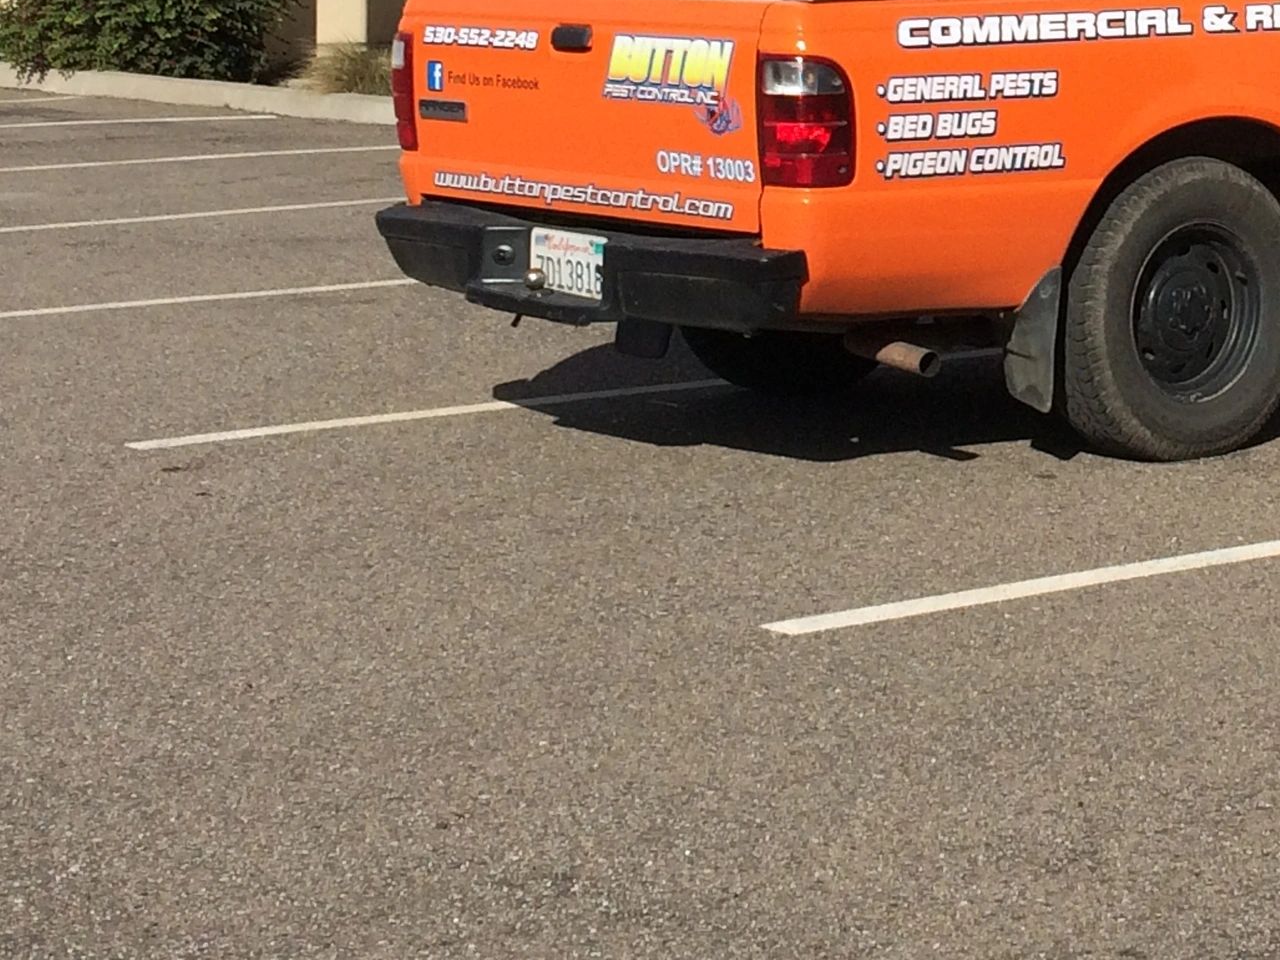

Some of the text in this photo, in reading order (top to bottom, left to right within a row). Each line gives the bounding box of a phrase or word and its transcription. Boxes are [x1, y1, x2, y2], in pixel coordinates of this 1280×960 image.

[423, 26, 538, 50] 530-552-2248
[898, 8, 1193, 47] COMMERCIAL
[1203, 5, 1239, 33] &
[606, 34, 735, 92] BUTTON
[448, 71, 540, 90] Find Us on Facebook
[602, 83, 636, 100] PEST
[637, 86, 695, 103] CONTROL
[989, 71, 1058, 98] PESTS
[935, 110, 997, 137] BUGS
[656, 150, 756, 183] OPR# 13003
[969, 144, 1065, 171] CONTROL
[433, 171, 734, 220] www.buttonpestcontrol.com
